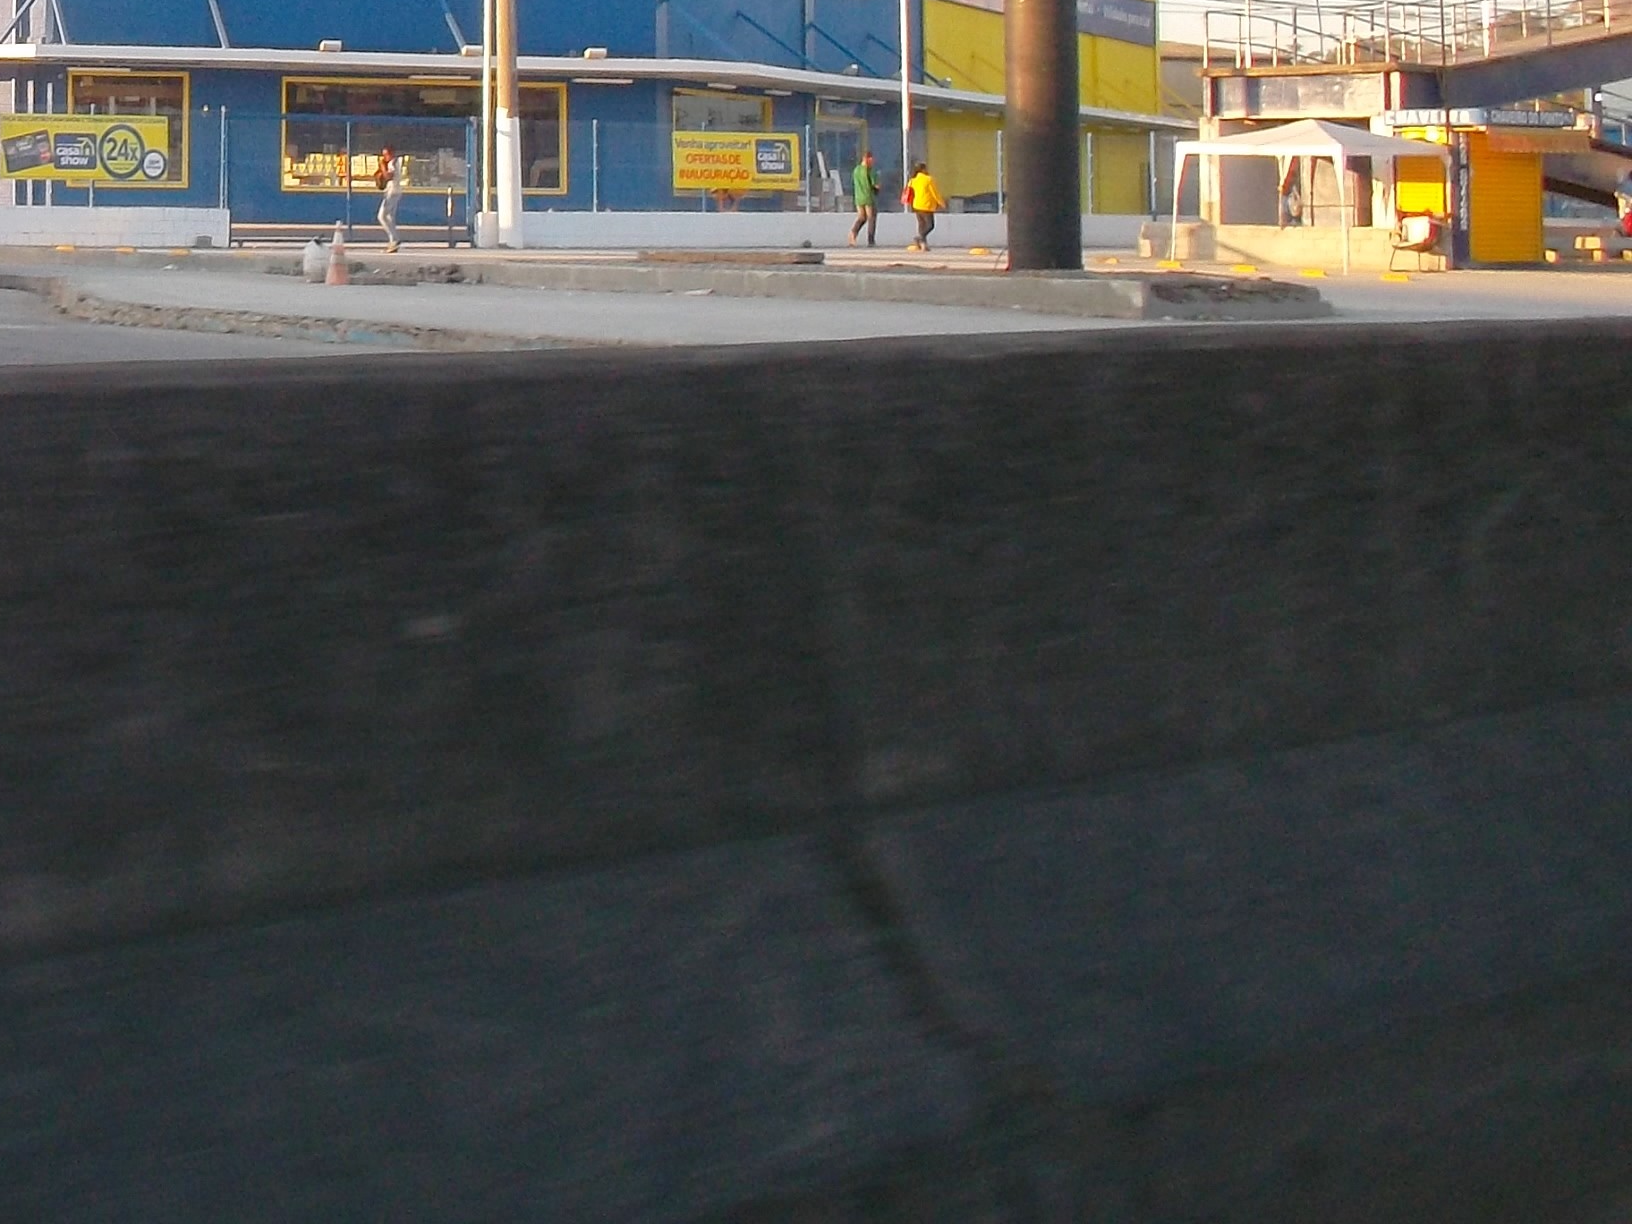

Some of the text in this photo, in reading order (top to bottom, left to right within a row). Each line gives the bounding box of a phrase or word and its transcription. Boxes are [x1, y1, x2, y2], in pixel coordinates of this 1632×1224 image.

[56, 147, 80, 156] casa
[106, 137, 139, 161] 24x
[60, 156, 89, 166] show
[728, 154, 742, 165] DE
